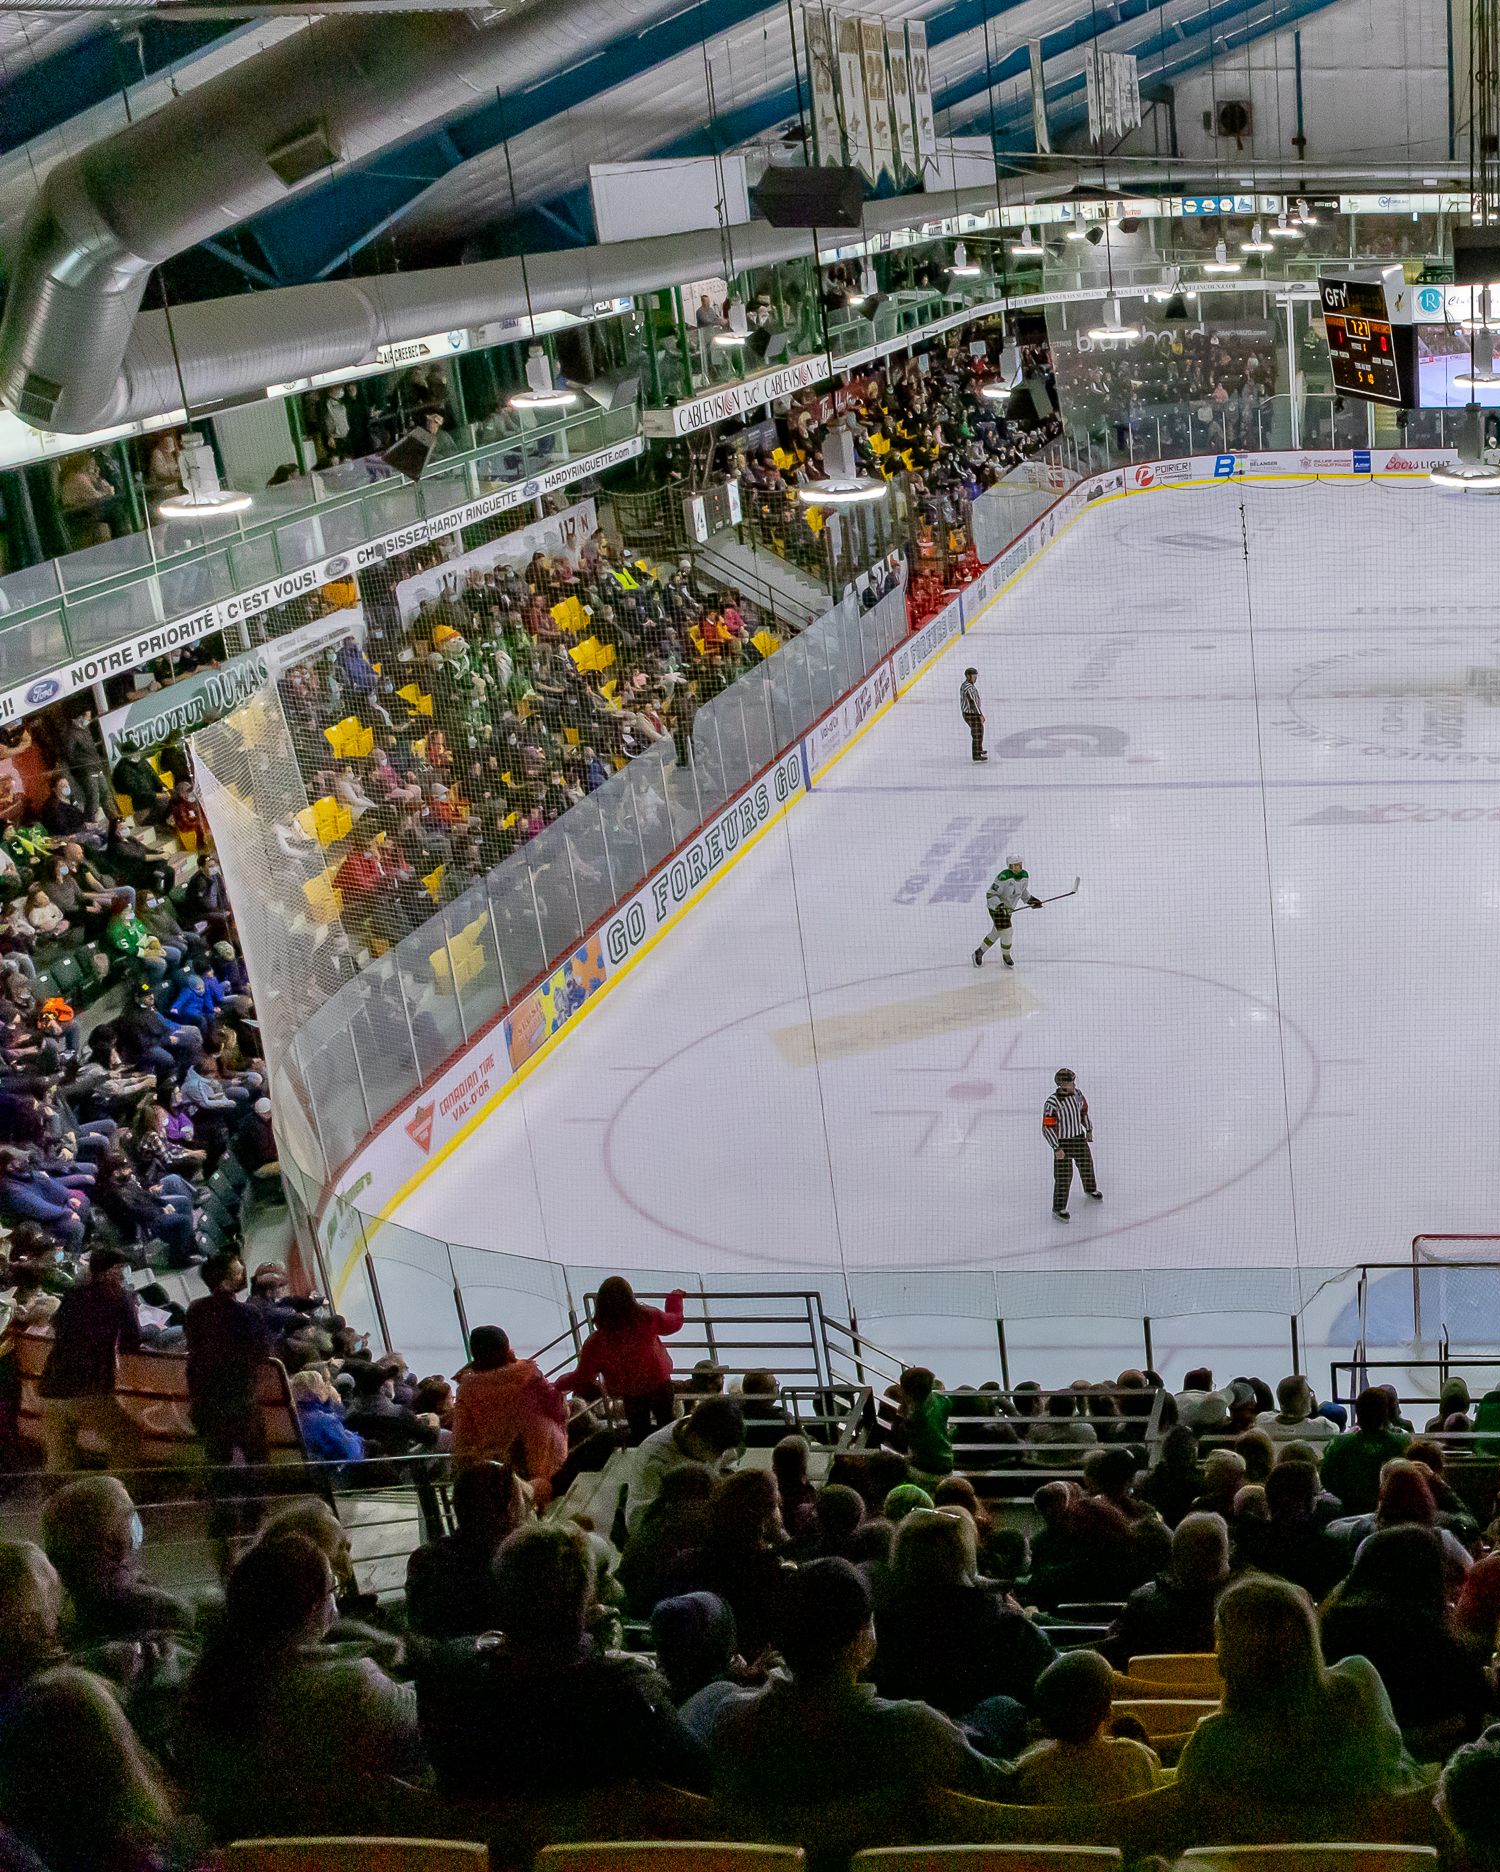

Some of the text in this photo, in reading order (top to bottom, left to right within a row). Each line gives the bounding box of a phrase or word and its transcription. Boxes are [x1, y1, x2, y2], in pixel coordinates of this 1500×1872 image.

[678, 391, 741, 432] CABLEVISION
[763, 363, 814, 399] CABLEVISION
[544, 446, 631, 490] HARDYRINGUETTE.com
[1155, 462, 1189, 474] POIRIER
[356, 525, 430, 566] CHISISSEZ
[429, 510, 464, 539] HARDY
[465, 490, 519, 530] RINGUETTE
[70, 648, 135, 687] NOTRE
[137, 608, 217, 659] PRIORITÉ
[226, 588, 272, 619] C'EST
[274, 571, 319, 597] VOUS!
[606, 753, 801, 965] GO FOREURS GO
[439, 1053, 495, 1118] CANADIAN TIRE
[451, 1079, 490, 1122] VAL-D'OR
